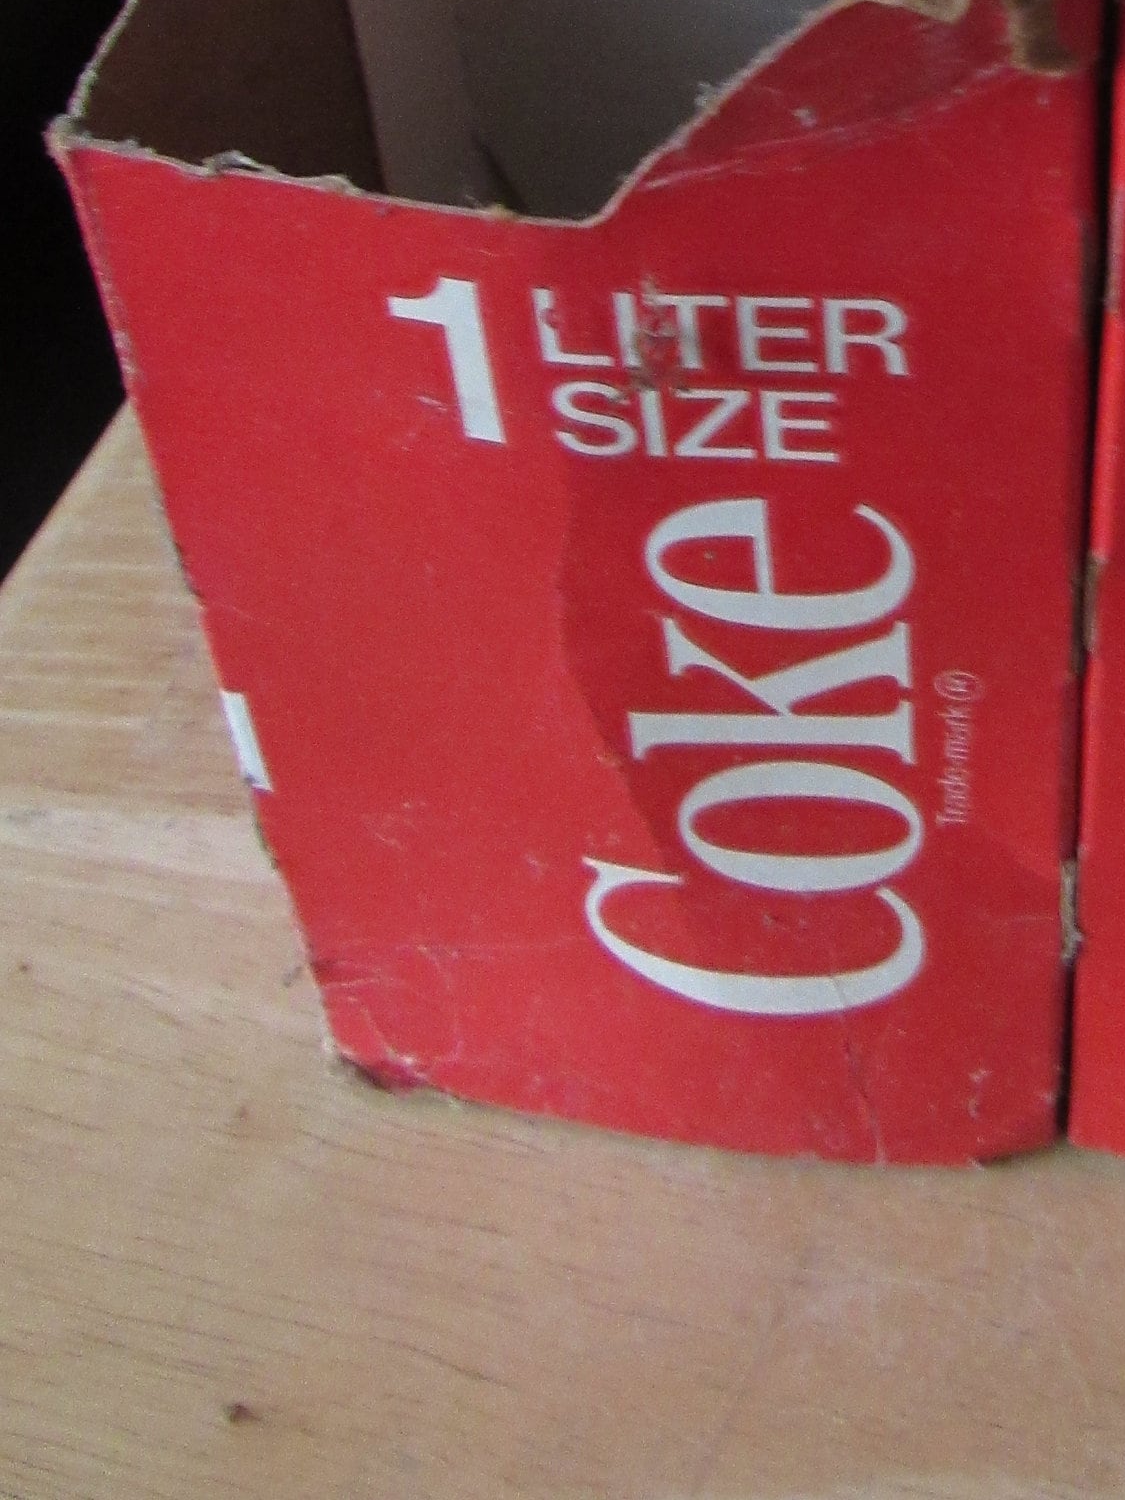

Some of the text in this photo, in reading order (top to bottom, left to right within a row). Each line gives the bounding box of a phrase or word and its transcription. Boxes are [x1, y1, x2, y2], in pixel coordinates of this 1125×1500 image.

[385, 275, 909, 446] 1 LITER
[550, 379, 841, 464] SIZE
[580, 496, 928, 1018] Coke
